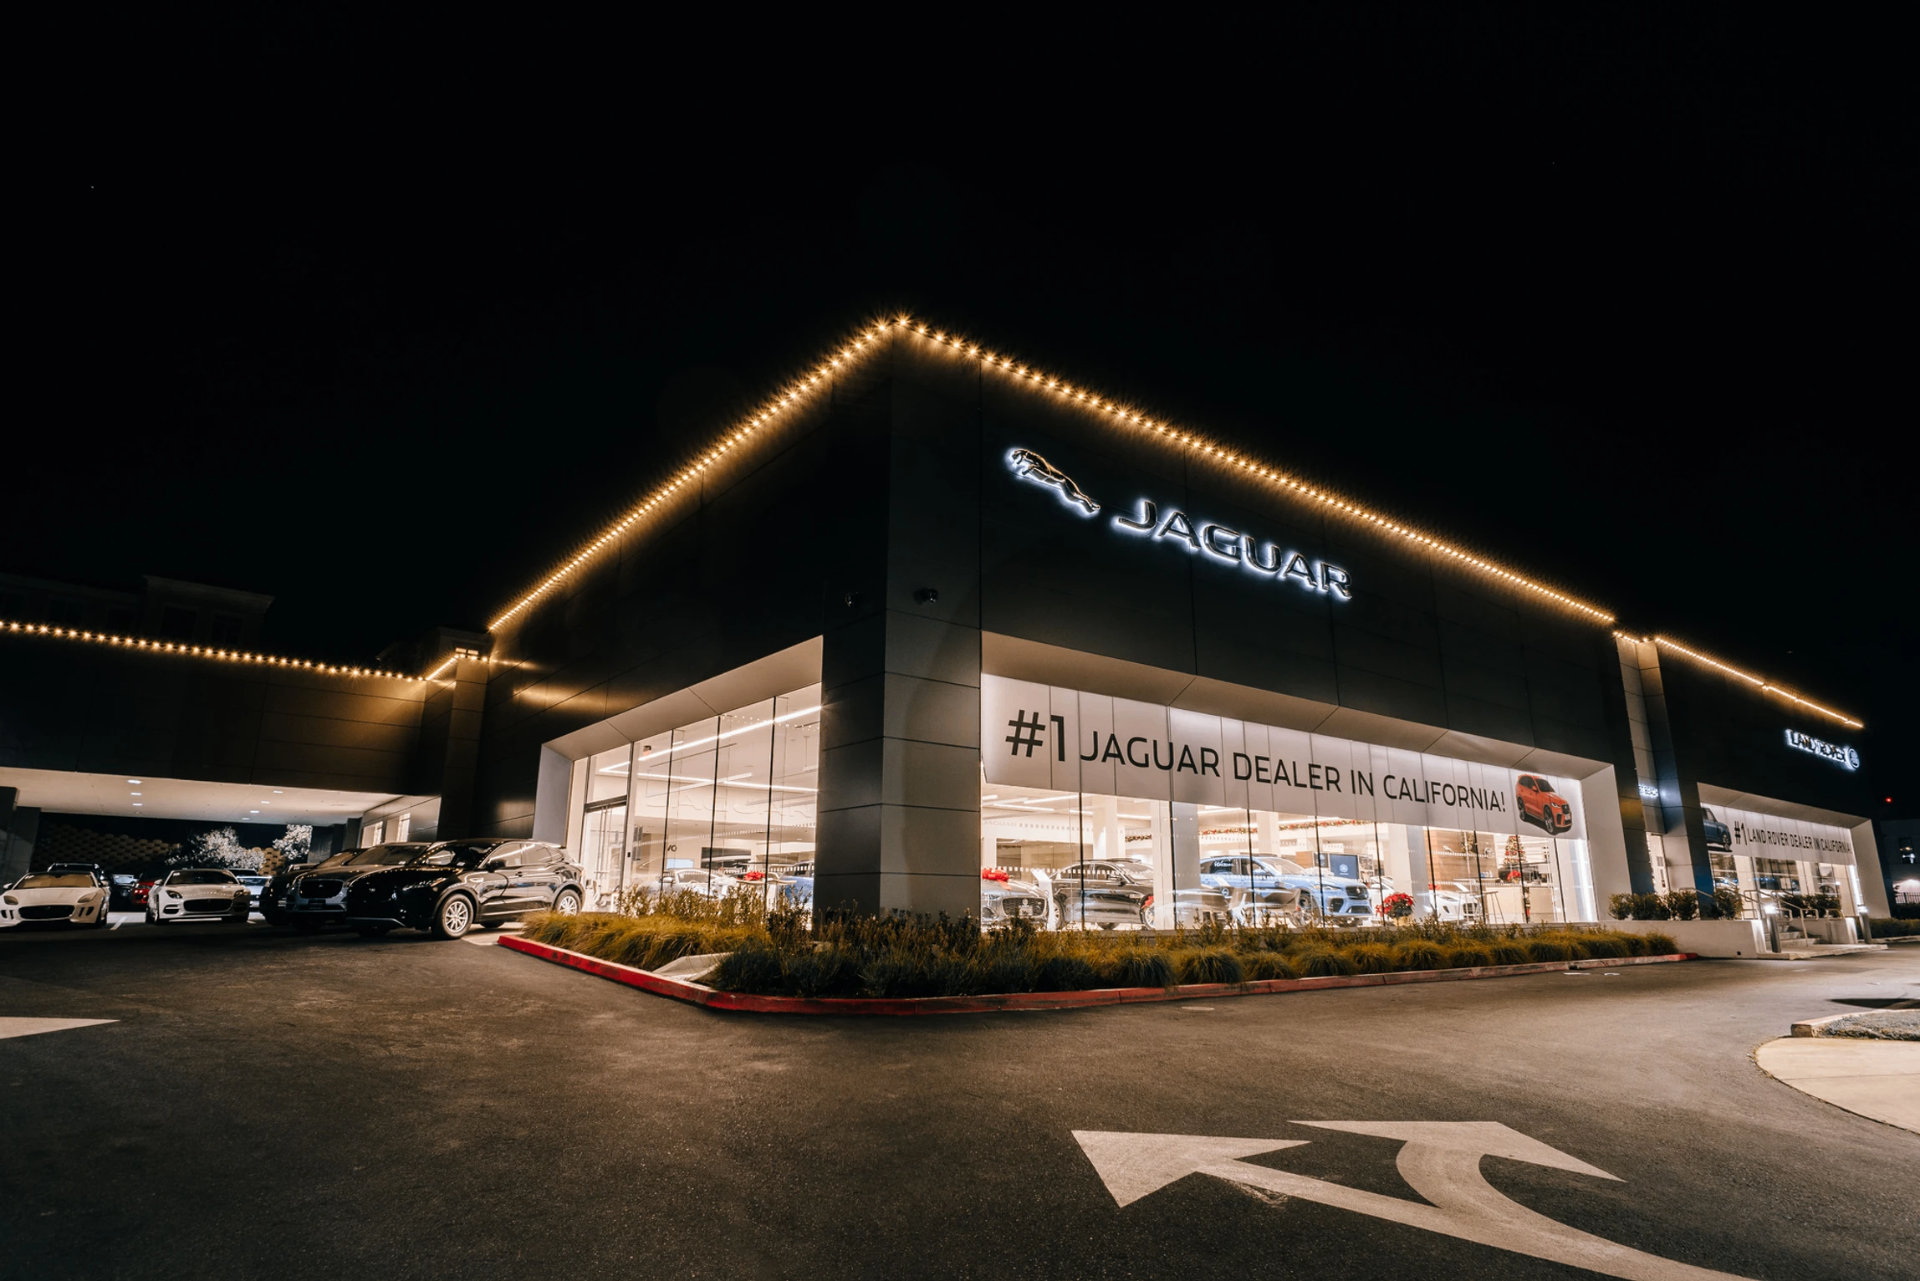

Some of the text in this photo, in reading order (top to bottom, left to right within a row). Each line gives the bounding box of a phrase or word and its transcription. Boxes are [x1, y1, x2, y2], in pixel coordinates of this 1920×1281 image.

[1115, 499, 1352, 600] JAGUAR
[1005, 709, 1506, 813] #1 JAGUAR DEALER IN CALIFORNIA!
[1734, 820, 1748, 846] #1
[1747, 828, 1767, 844] LAND
[1767, 830, 1790, 847] ROVER
[1790, 833, 1813, 850] DEALER
